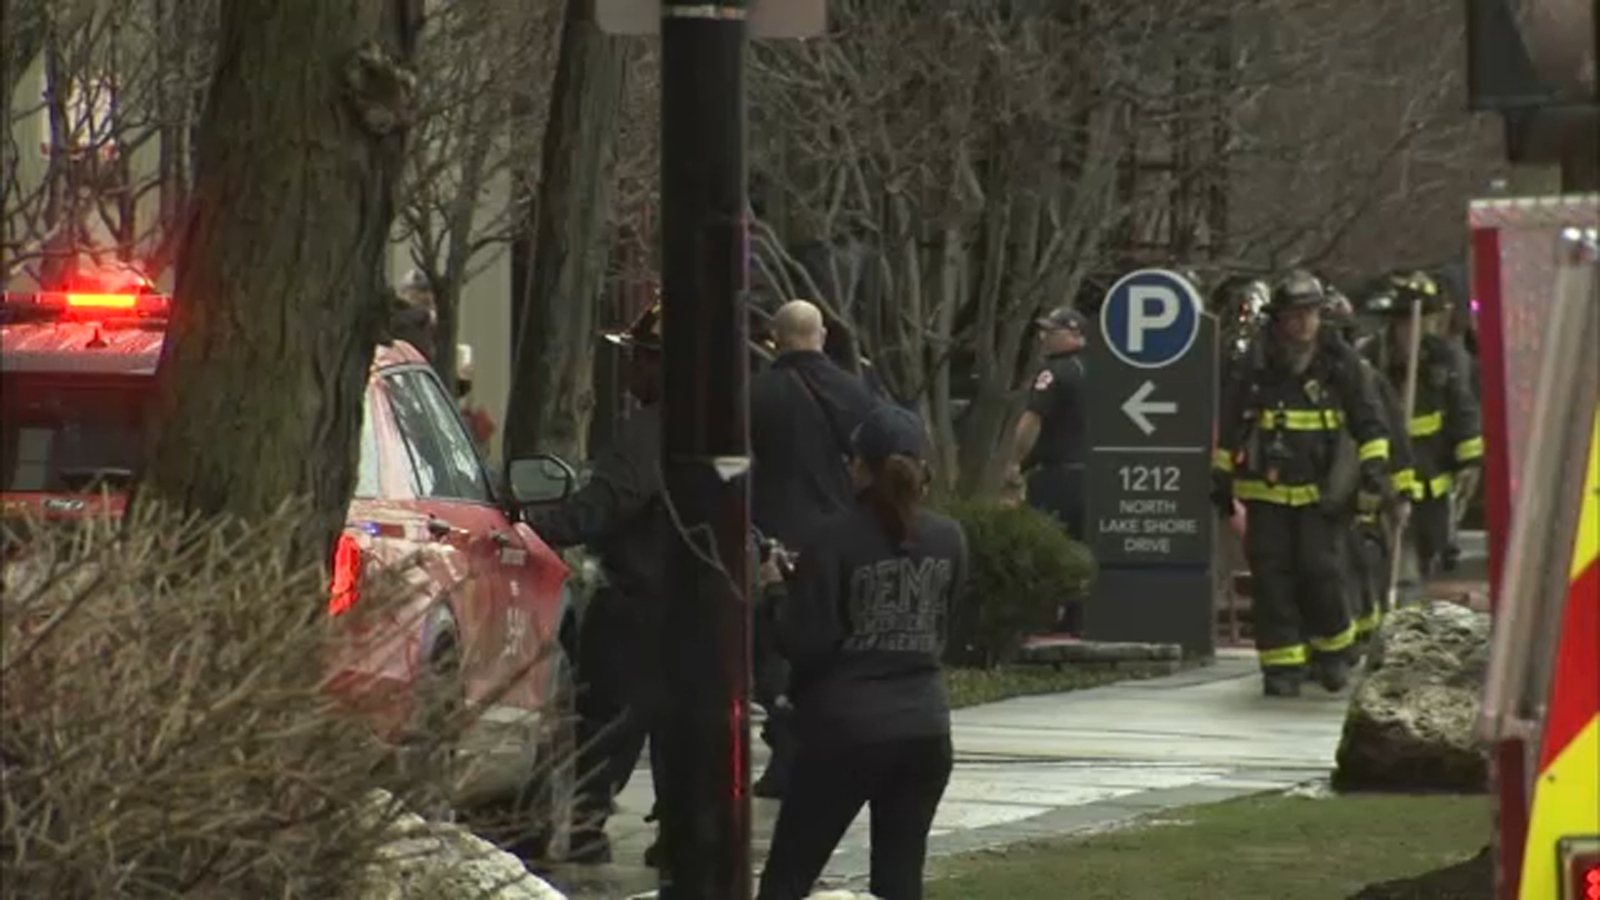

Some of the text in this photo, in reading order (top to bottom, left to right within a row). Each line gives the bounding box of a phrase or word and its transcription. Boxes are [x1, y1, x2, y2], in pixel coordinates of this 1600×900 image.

[1126, 285, 1180, 353] P
[1119, 466, 1181, 491] 1212
[1119, 499, 1176, 514] NORTH
[1099, 519, 1197, 534] LAKE SHORE
[1124, 537, 1170, 553] DRIVE
